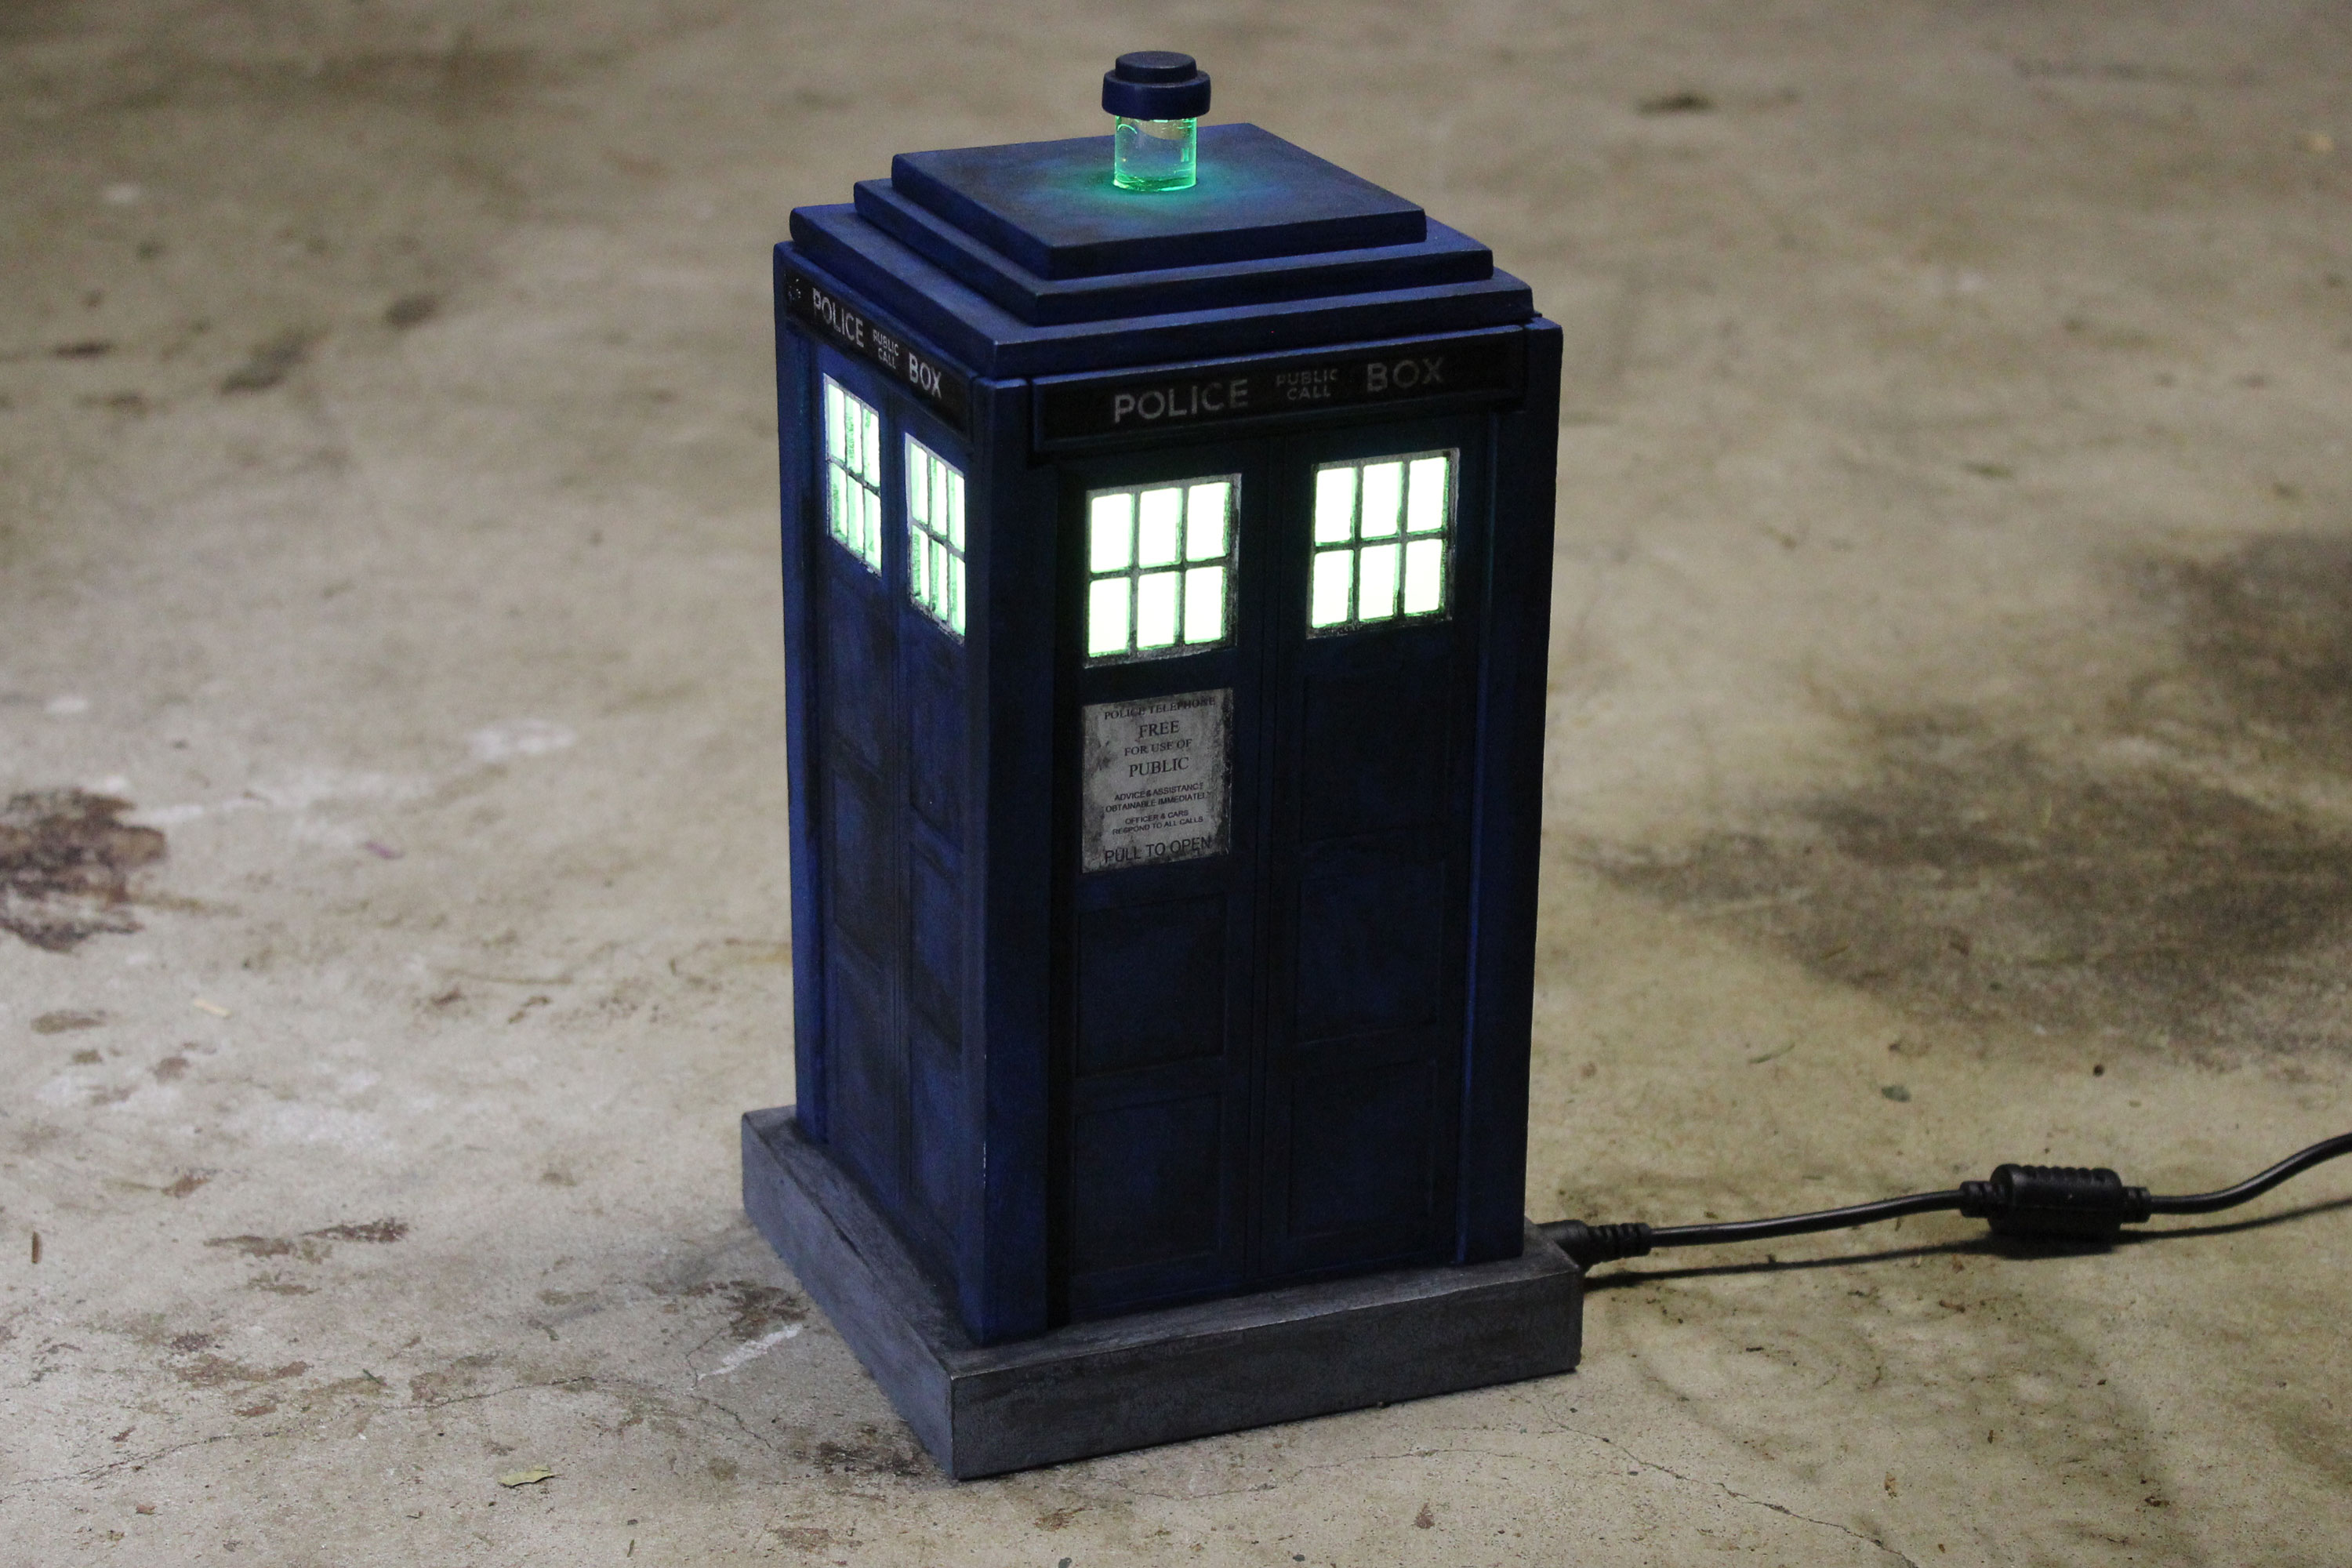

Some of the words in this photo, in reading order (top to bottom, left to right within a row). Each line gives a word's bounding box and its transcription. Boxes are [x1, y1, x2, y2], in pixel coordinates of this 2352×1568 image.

[812, 287, 865, 348] POLICE
[877, 347, 897, 369] CALL
[909, 351, 942, 399] BOX
[1276, 368, 1338, 387] PUBLIC
[1367, 357, 1445, 393] BOX
[1114, 379, 1249, 423] POLICE
[1287, 385, 1331, 401] CALL
[1104, 706, 1145, 720] POLICE
[1149, 696, 1216, 714] TELEPHONE
[1138, 720, 1180, 739] FREE
[1124, 745, 1149, 757] FOR
[1151, 742, 1174, 753] USE
[1176, 739, 1192, 750] OF
[1129, 757, 1189, 779] PUBLIC
[1114, 789, 1146, 801] ADVICE
[1153, 782, 1204, 796] ASSISTANCE
[1105, 799, 1156, 812] OBTAINABLE
[1112, 825, 1150, 836] RESPOND
[1179, 816, 1203, 825] CALLS
[1125, 815, 1159, 825] OFFICER
[1167, 810, 1189, 818] CARS
[1104, 846, 1142, 863] PULL
[1145, 842, 1166, 857] TO
[1170, 835, 1212, 852] OPEN
